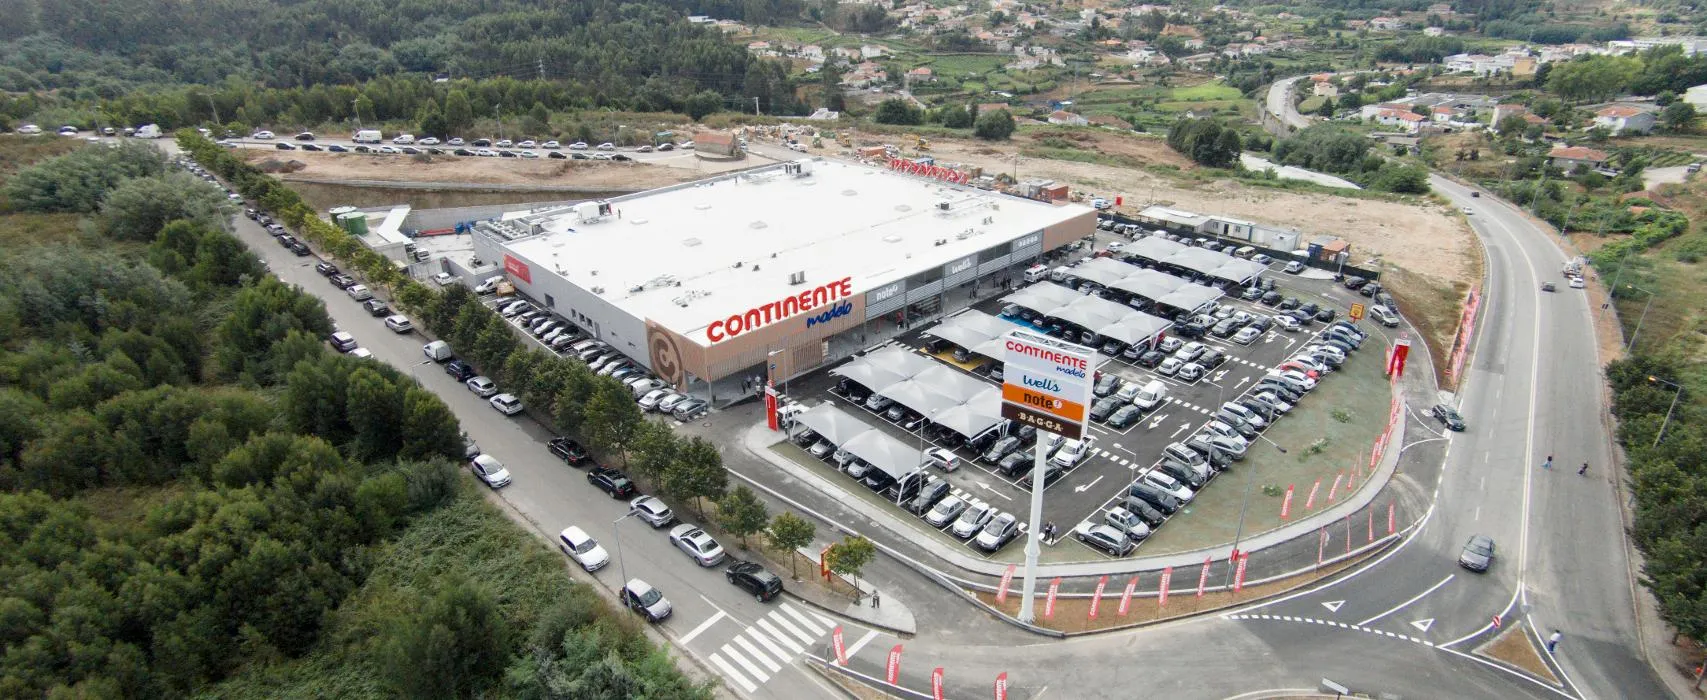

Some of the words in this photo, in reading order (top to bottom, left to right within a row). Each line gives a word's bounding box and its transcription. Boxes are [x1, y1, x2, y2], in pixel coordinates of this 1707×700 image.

[706, 276, 852, 342] CONTINENTE
[806, 299, 853, 328] modelo
[1005, 340, 1087, 371] CONTINENTE
[1023, 375, 1061, 392] wells
[1056, 365, 1086, 379] modelo
